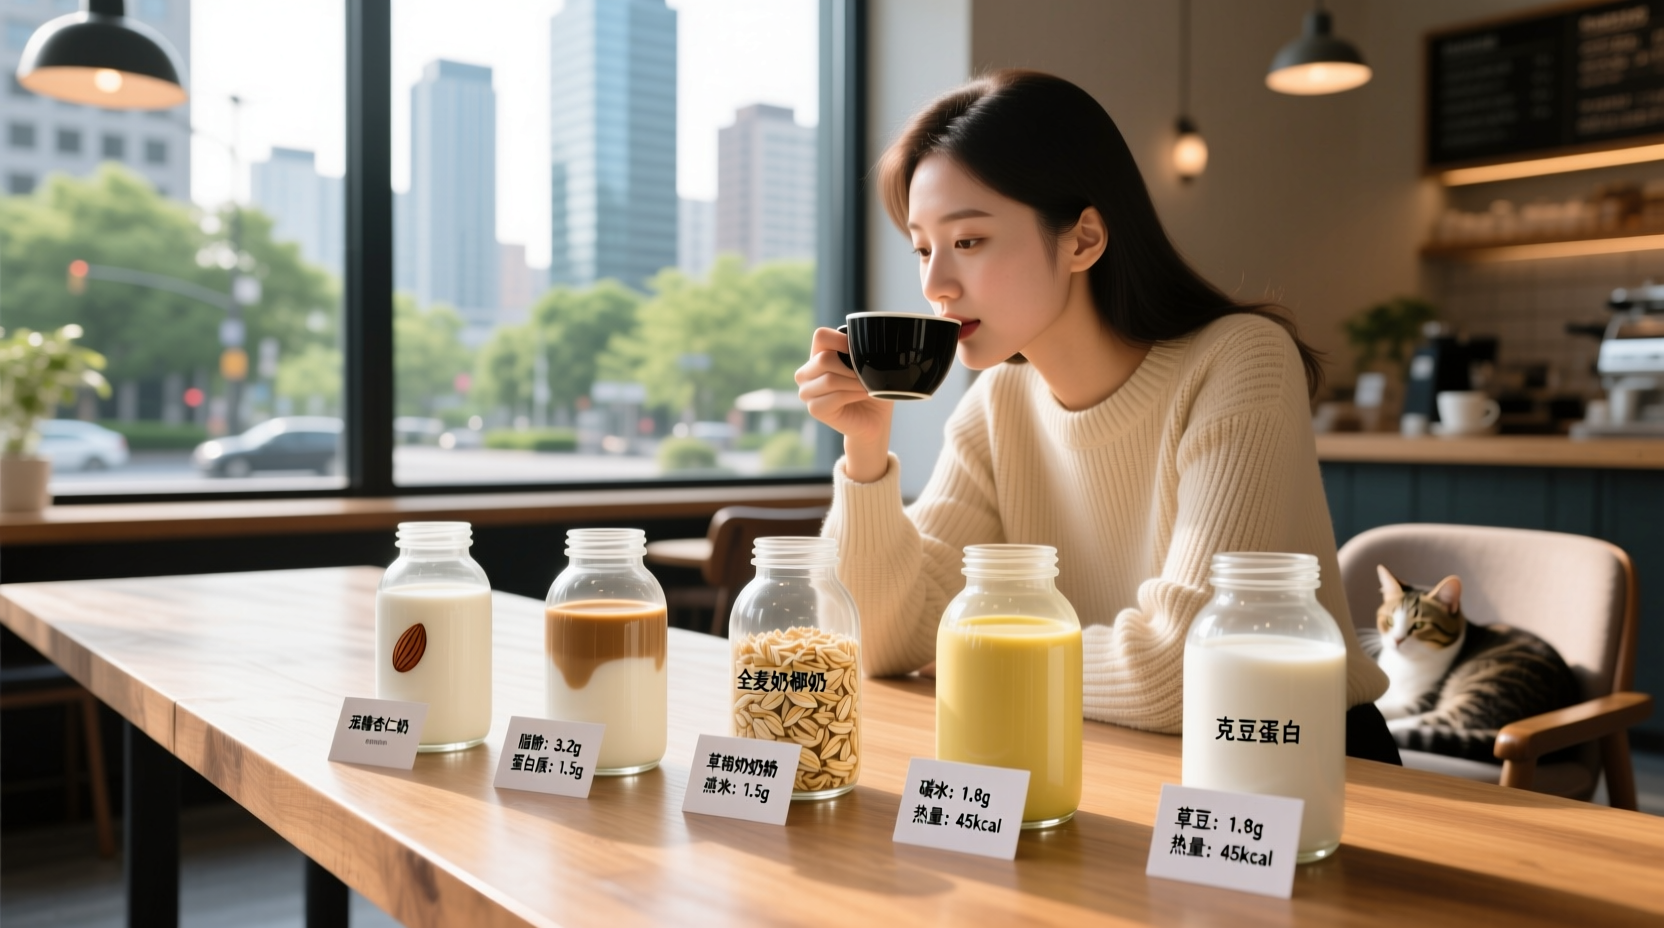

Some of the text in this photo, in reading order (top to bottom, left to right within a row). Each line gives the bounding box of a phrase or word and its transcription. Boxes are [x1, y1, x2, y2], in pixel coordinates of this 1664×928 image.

[1215, 716, 1300, 745] 克豆蛋白
[554, 738, 582, 757] 3.2g
[560, 761, 583, 780] 1.5g
[744, 782, 770, 803] 1.5g
[962, 786, 991, 808] 1.8g
[955, 813, 1002, 833] 45kcal
[1230, 816, 1263, 840] 1.8g
[1220, 844, 1273, 867] 45kcal
